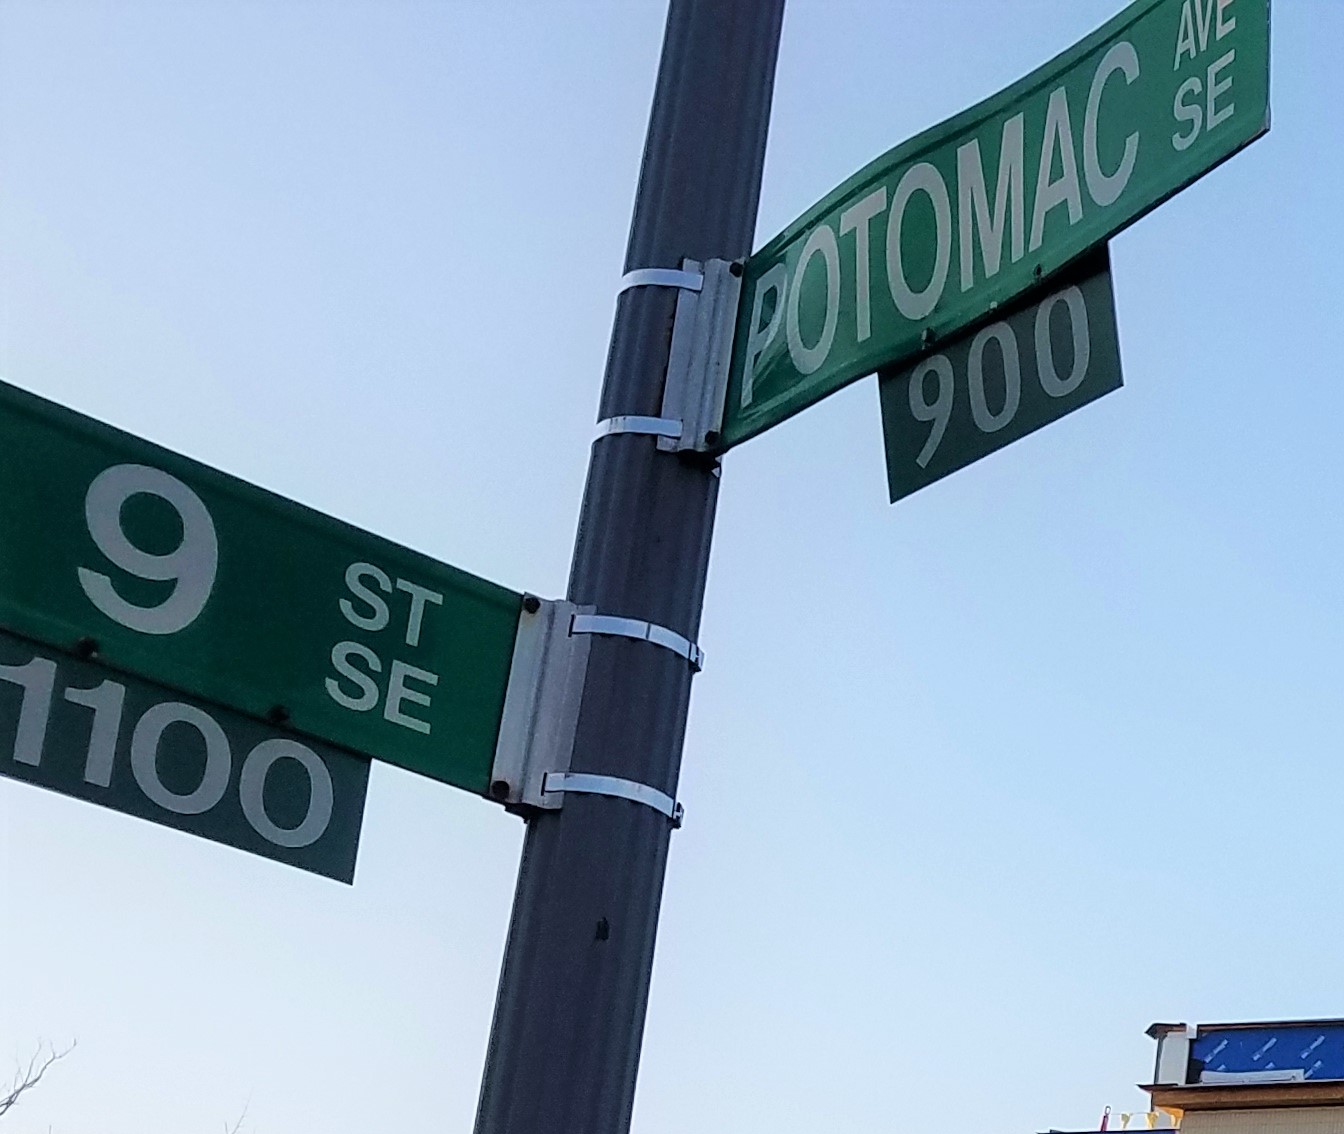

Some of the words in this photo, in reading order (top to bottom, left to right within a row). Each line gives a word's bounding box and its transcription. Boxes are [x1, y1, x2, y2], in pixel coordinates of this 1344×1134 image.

[1171, 48, 1236, 151] SE
[1173, 0, 1236, 71] AVE
[743, 41, 1140, 407] POTOMAC
[905, 283, 1092, 468] 900
[77, 463, 219, 635] 9
[338, 561, 443, 648] ST
[0, 656, 334, 848] 1100
[324, 639, 440, 734] SE
